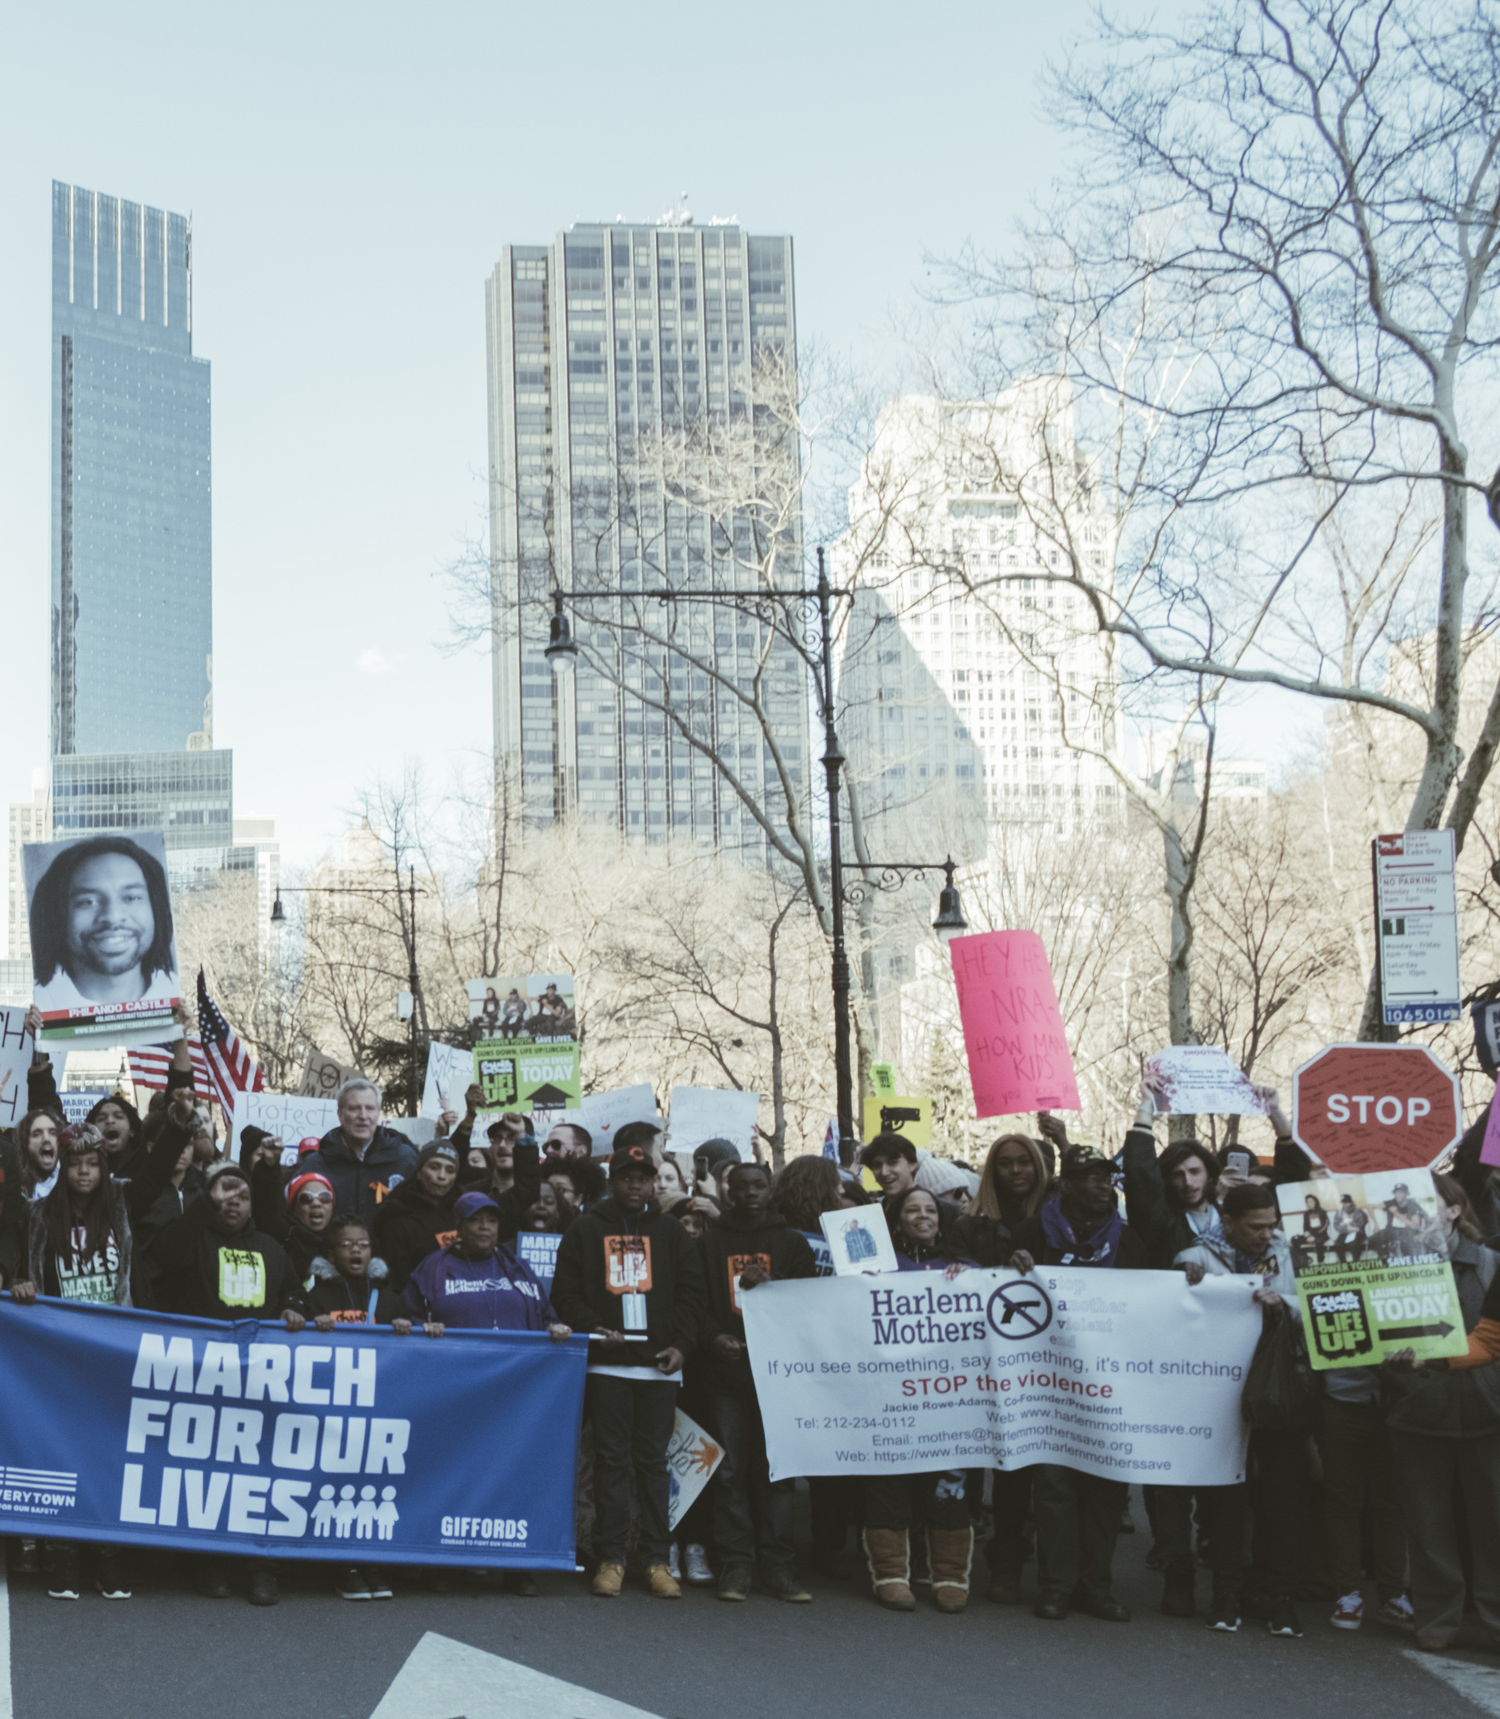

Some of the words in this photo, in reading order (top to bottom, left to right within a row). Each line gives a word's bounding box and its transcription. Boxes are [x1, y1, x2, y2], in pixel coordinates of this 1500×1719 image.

[1383, 878, 1395, 886] NO
[1398, 876, 1437, 885] PARKING
[69, 1004, 123, 1018] PHILANDO
[125, 998, 171, 1012] CASTILE
[520, 1047, 533, 1055] LIFE
[976, 1035, 1021, 1063] HOW
[520, 1065, 574, 1083] TODAY
[1013, 1054, 1054, 1081] KIDS
[483, 1074, 514, 1090] LIFE
[62, 1099, 95, 1107] MARCH
[485, 1088, 515, 1103] UP
[246, 1094, 333, 1127] Protect
[1327, 1093, 1431, 1125] STOP
[1299, 1265, 1349, 1277] EMPOWER
[1387, 1256, 1412, 1268] SAVE
[1414, 1253, 1443, 1265] LIVES.
[1303, 1279, 1329, 1290] GUNS
[1332, 1276, 1365, 1288] DOWN,
[1367, 1272, 1386, 1284] LIFE
[1387, 1268, 1445, 1282] UP/LINCOLN
[1369, 1285, 1414, 1299] LAUNCH
[1416, 1282, 1447, 1295] EVENT
[870, 1287, 984, 1316] Harlem
[1370, 1294, 1450, 1322] TODAY
[872, 1316, 986, 1345] Mothers
[1316, 1311, 1363, 1333] LIFE
[1319, 1331, 1366, 1352] UP
[131, 1333, 377, 1407] MARCH
[768, 1360, 779, 1375] If
[784, 1361, 815, 1377] you
[820, 1361, 851, 1374] see
[857, 1357, 955, 1374] something,
[961, 1354, 991, 1371] say
[998, 1350, 1089, 1374] something,
[1096, 1356, 1119, 1373] it's
[1125, 1359, 1154, 1374] not
[1160, 1358, 1243, 1381] snitching
[902, 1375, 968, 1396] STOP
[976, 1374, 1011, 1392] the
[1018, 1370, 1113, 1398] violence
[882, 1401, 919, 1413] Jackie
[922, 1397, 1001, 1411] Rowe-Adams,
[1004, 1394, 1123, 1416] Co-Founder/President
[126, 1396, 264, 1465] FOR
[271, 1412, 411, 1475] OUR
[795, 1417, 819, 1429] Tel:
[823, 1416, 916, 1429] 212-234-0112
[986, 1411, 1018, 1424] Web:
[1020, 1408, 1212, 1439] www.harlemmotherssave.org
[872, 1434, 914, 1446] Email:
[918, 1425, 1133, 1454] mothers@harlemmotherssave.org
[835, 1450, 870, 1462] Web:
[874, 1439, 1171, 1471] https://www.facebook.com/harlemmotherssave
[13, 1504, 30, 1513] GUN
[30, 1506, 59, 1516] SAFETY
[119, 1463, 312, 1538] LIVES
[441, 1515, 528, 1540] GIFFORDS
